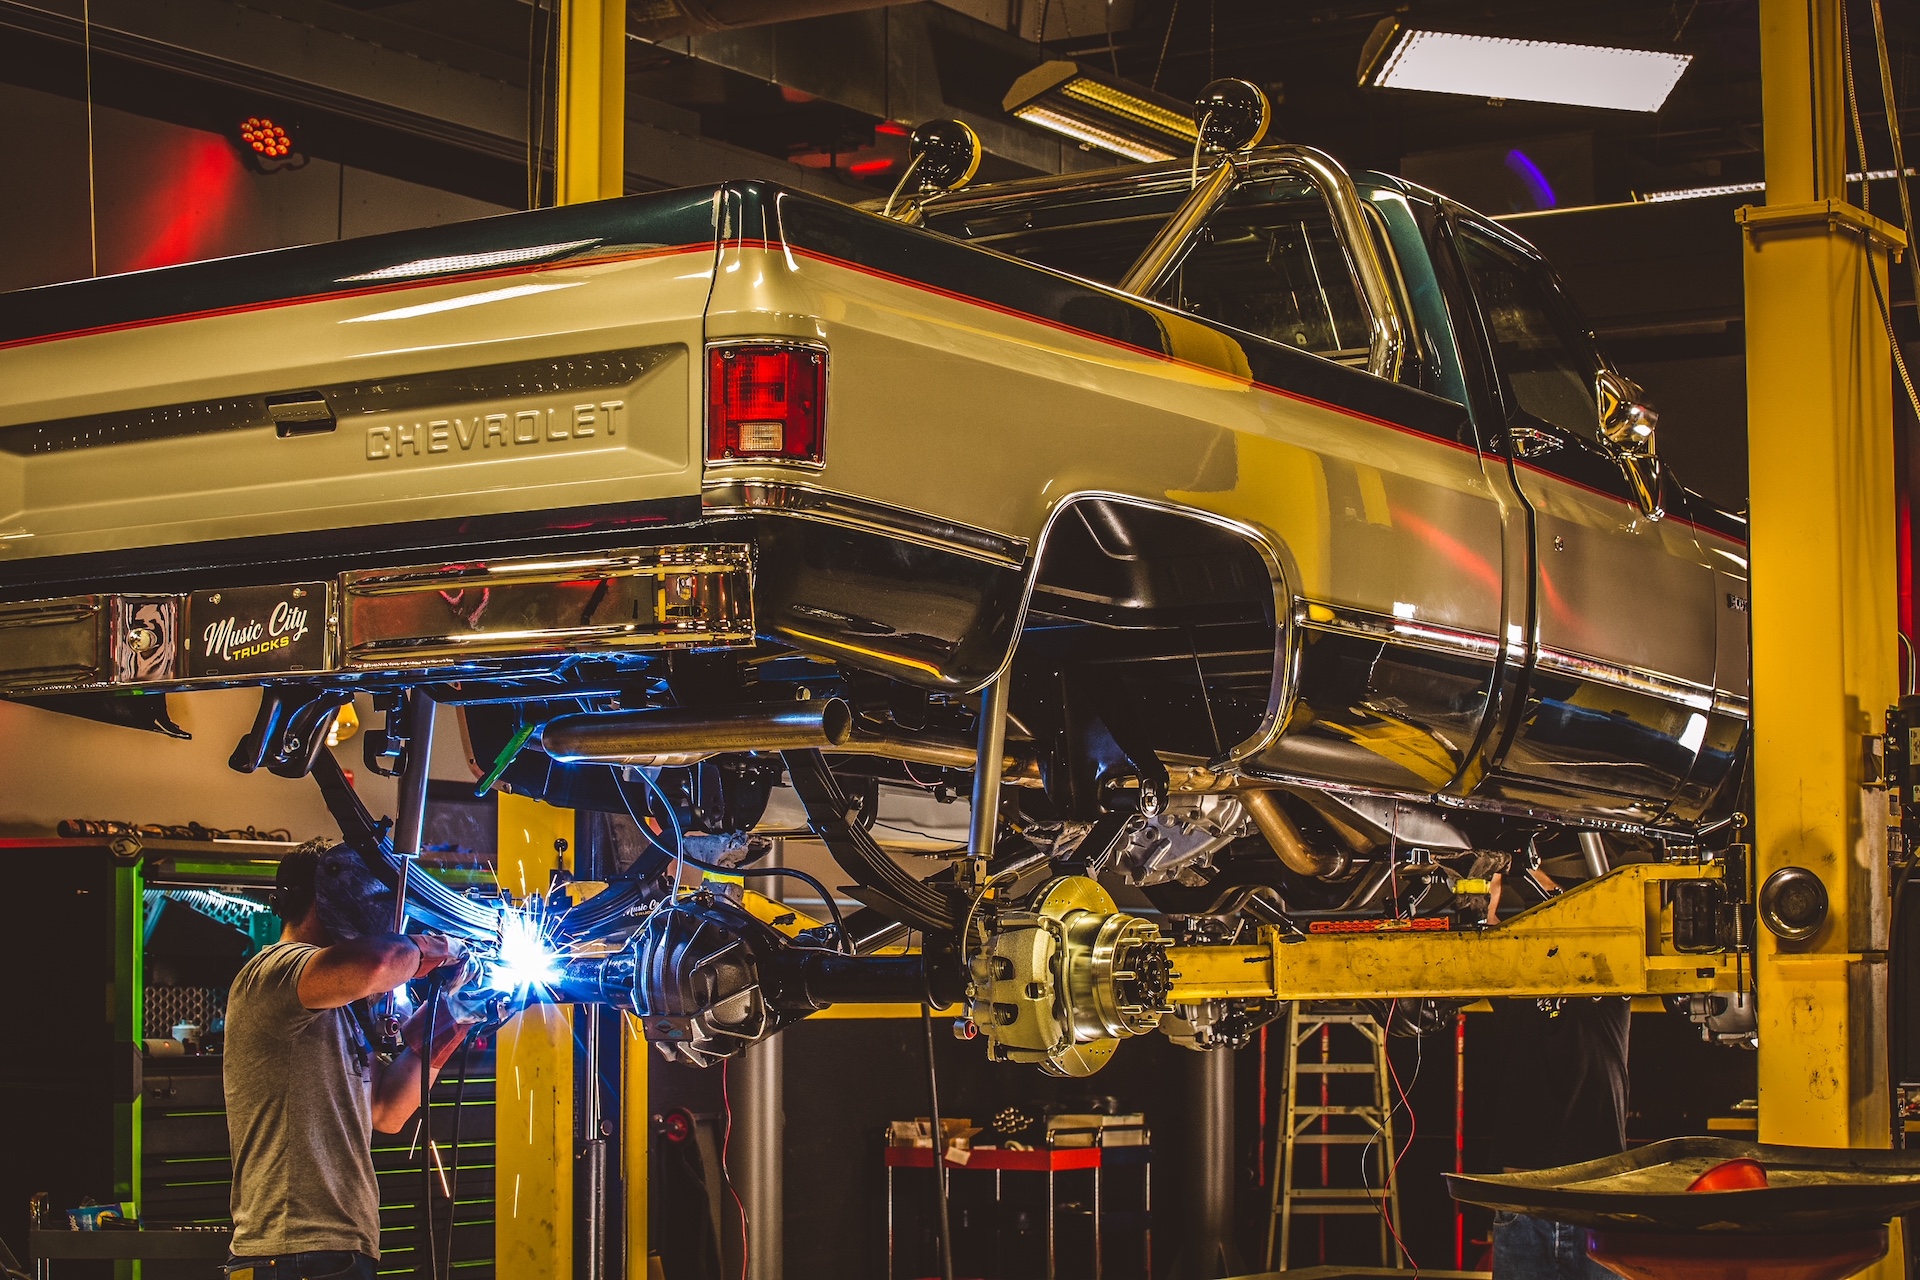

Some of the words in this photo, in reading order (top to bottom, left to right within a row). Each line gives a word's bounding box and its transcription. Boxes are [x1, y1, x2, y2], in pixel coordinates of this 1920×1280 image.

[366, 400, 624, 460] CHEVROLET
[203, 616, 264, 661] Music
[268, 601, 309, 642] City
[232, 635, 290, 661] TRUCKS
